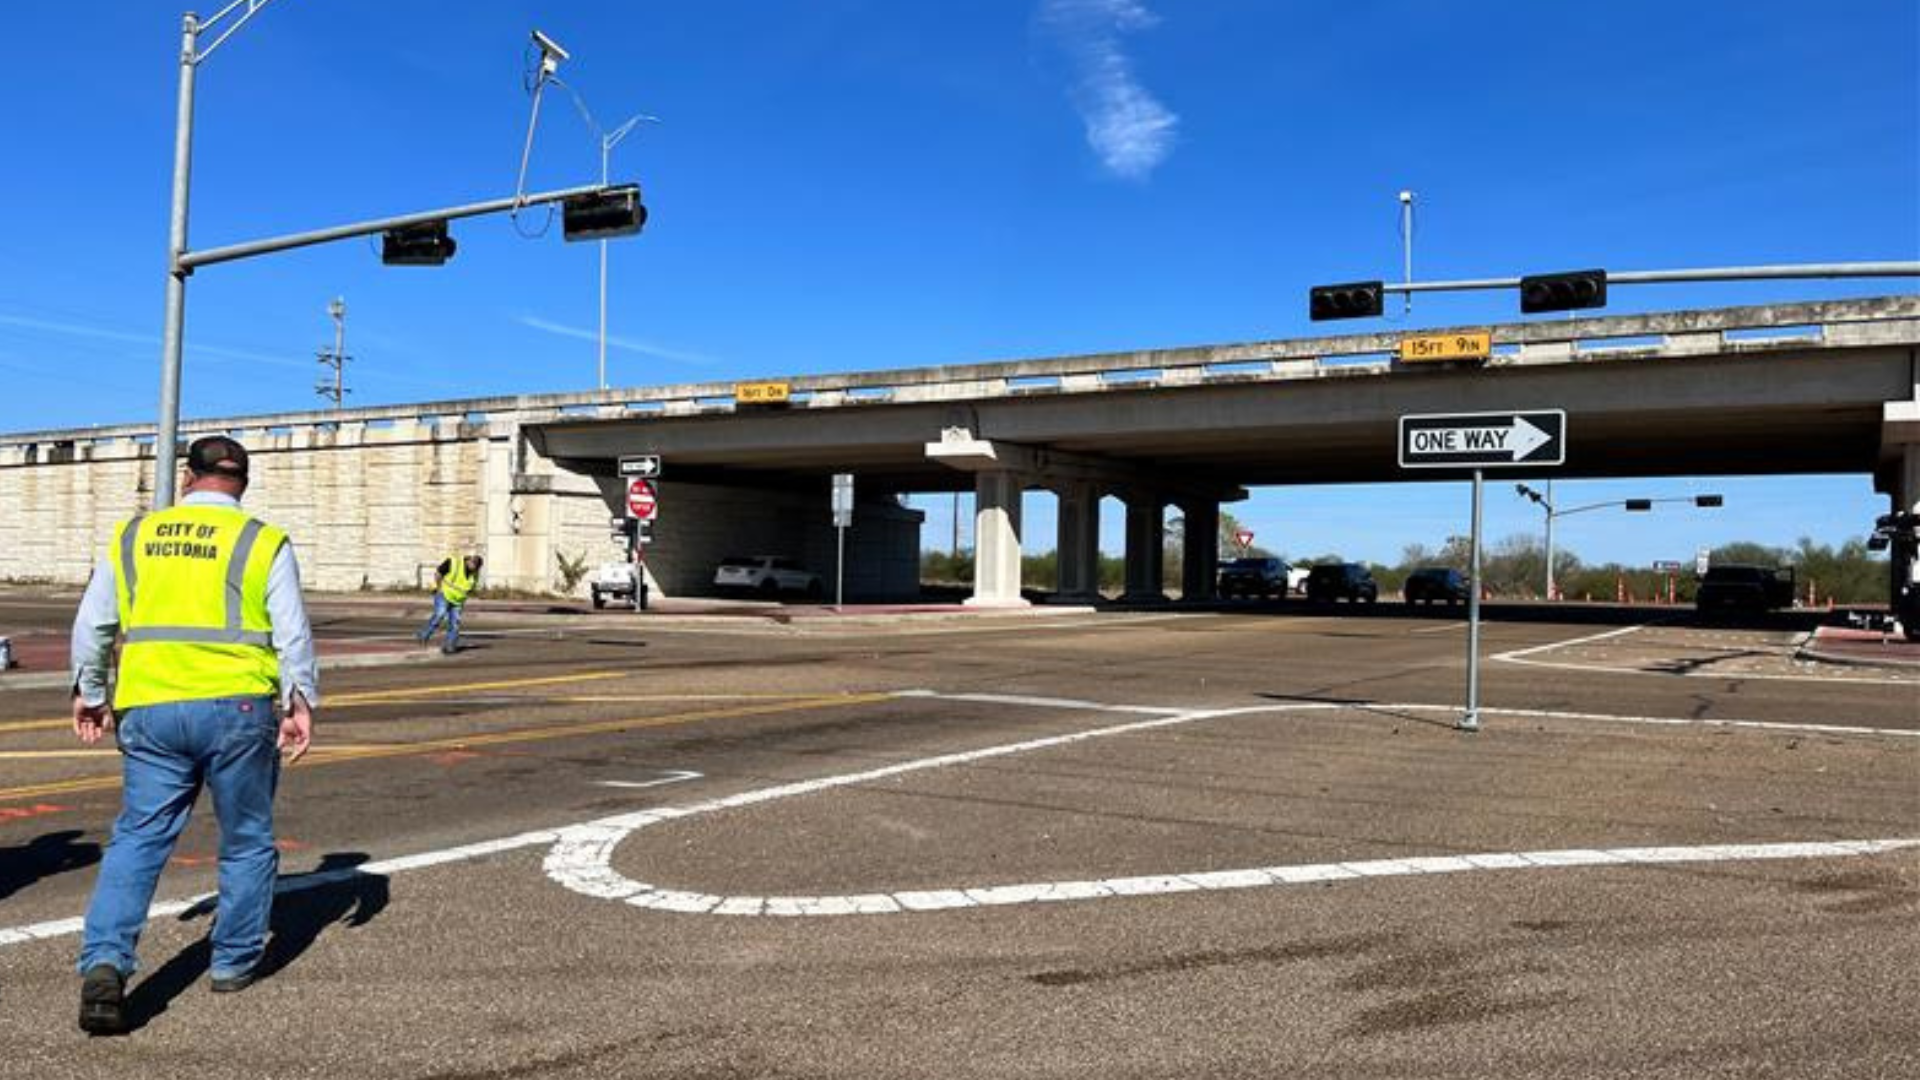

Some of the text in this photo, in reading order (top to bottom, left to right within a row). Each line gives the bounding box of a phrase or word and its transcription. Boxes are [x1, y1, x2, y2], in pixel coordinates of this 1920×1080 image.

[1412, 337, 1479, 355] 15FT 9IN
[1415, 430, 1509, 451] ONE WAY
[156, 523, 218, 539] CITY OF
[144, 541, 217, 560] VICTORIA
